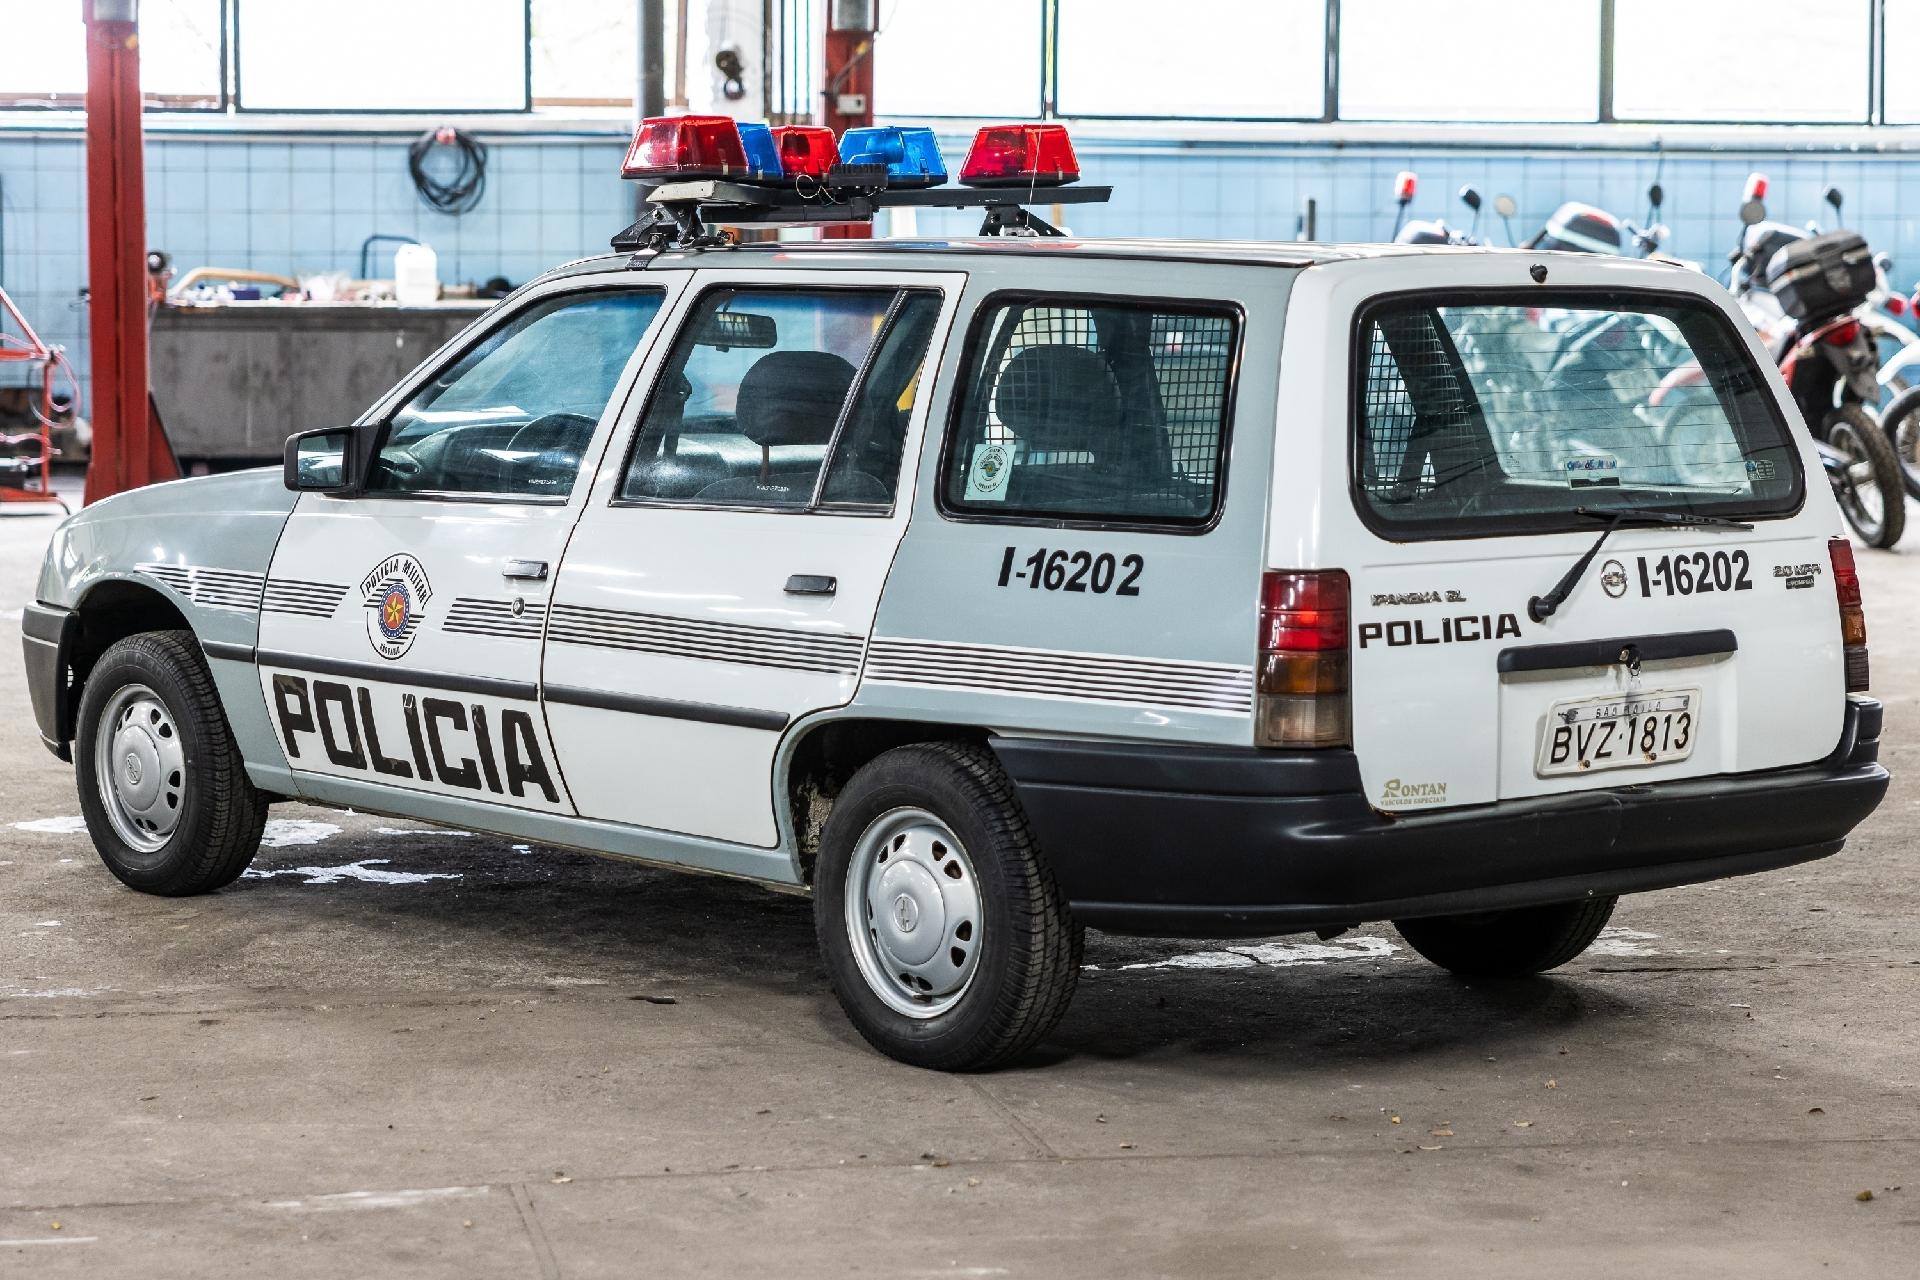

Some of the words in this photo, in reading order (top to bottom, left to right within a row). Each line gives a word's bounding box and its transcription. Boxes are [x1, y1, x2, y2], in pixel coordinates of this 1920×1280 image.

[402, 560, 427, 604] MILITAR
[998, 547, 1144, 596] I-16202
[1637, 550, 1752, 597] I-16202
